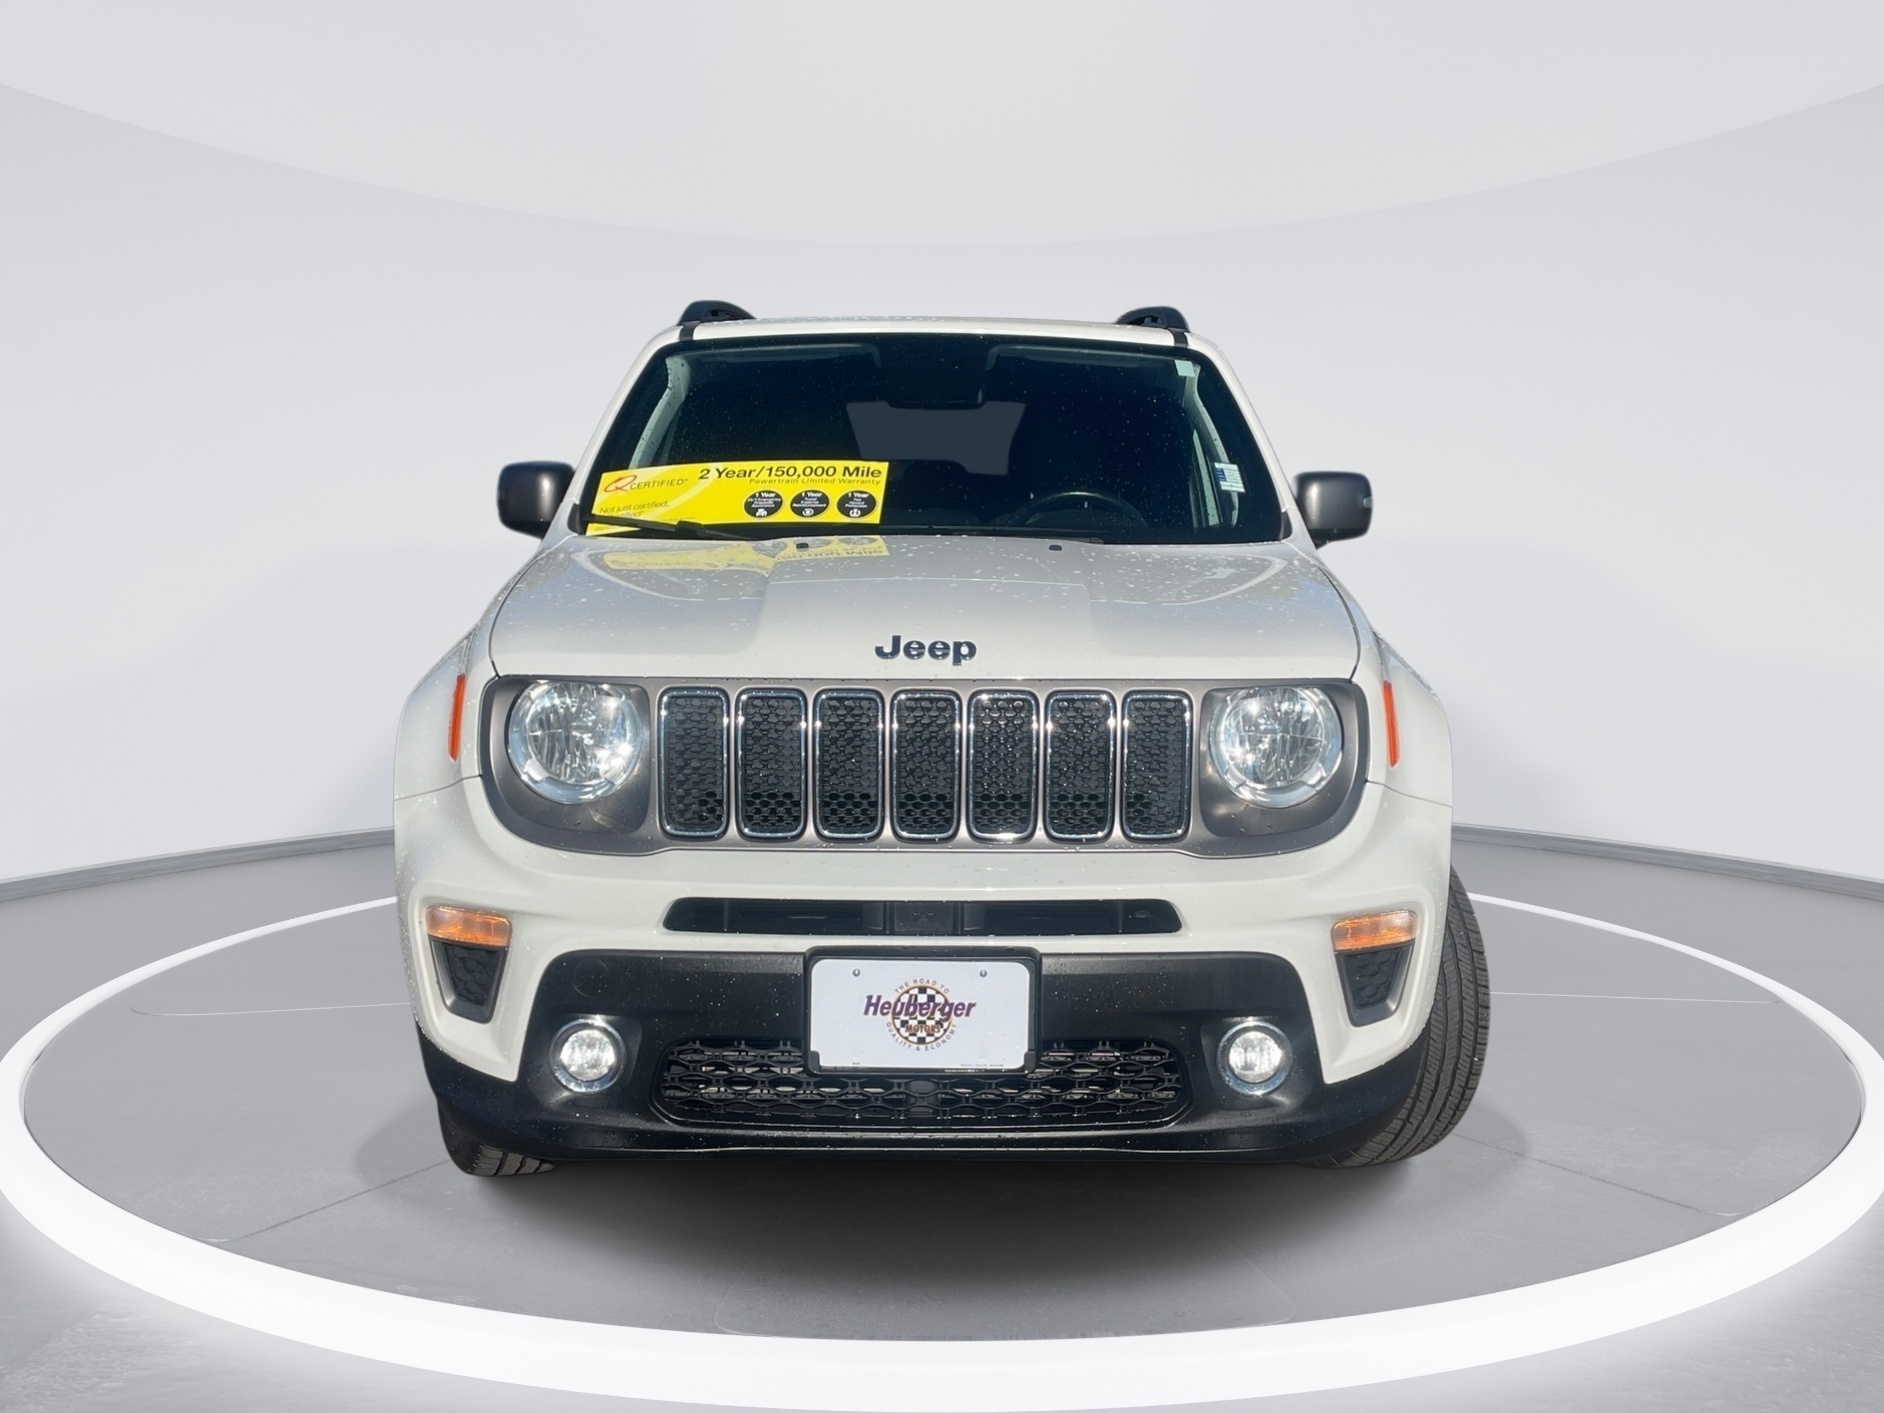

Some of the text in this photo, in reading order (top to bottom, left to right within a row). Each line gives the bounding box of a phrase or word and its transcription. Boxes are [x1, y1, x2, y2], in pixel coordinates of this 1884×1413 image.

[698, 465, 882, 479] 2 Year/150,000 Mile
[838, 478, 881, 486] Warranty
[875, 635, 977, 666] Jeep
[895, 978, 950, 994] THE ROAD TO
[863, 994, 977, 1022] Heuberger
[886, 1021, 912, 1050] QUALITY
[925, 1024, 958, 1052] ECONOMY
[905, 1024, 941, 1034] MOTORS
